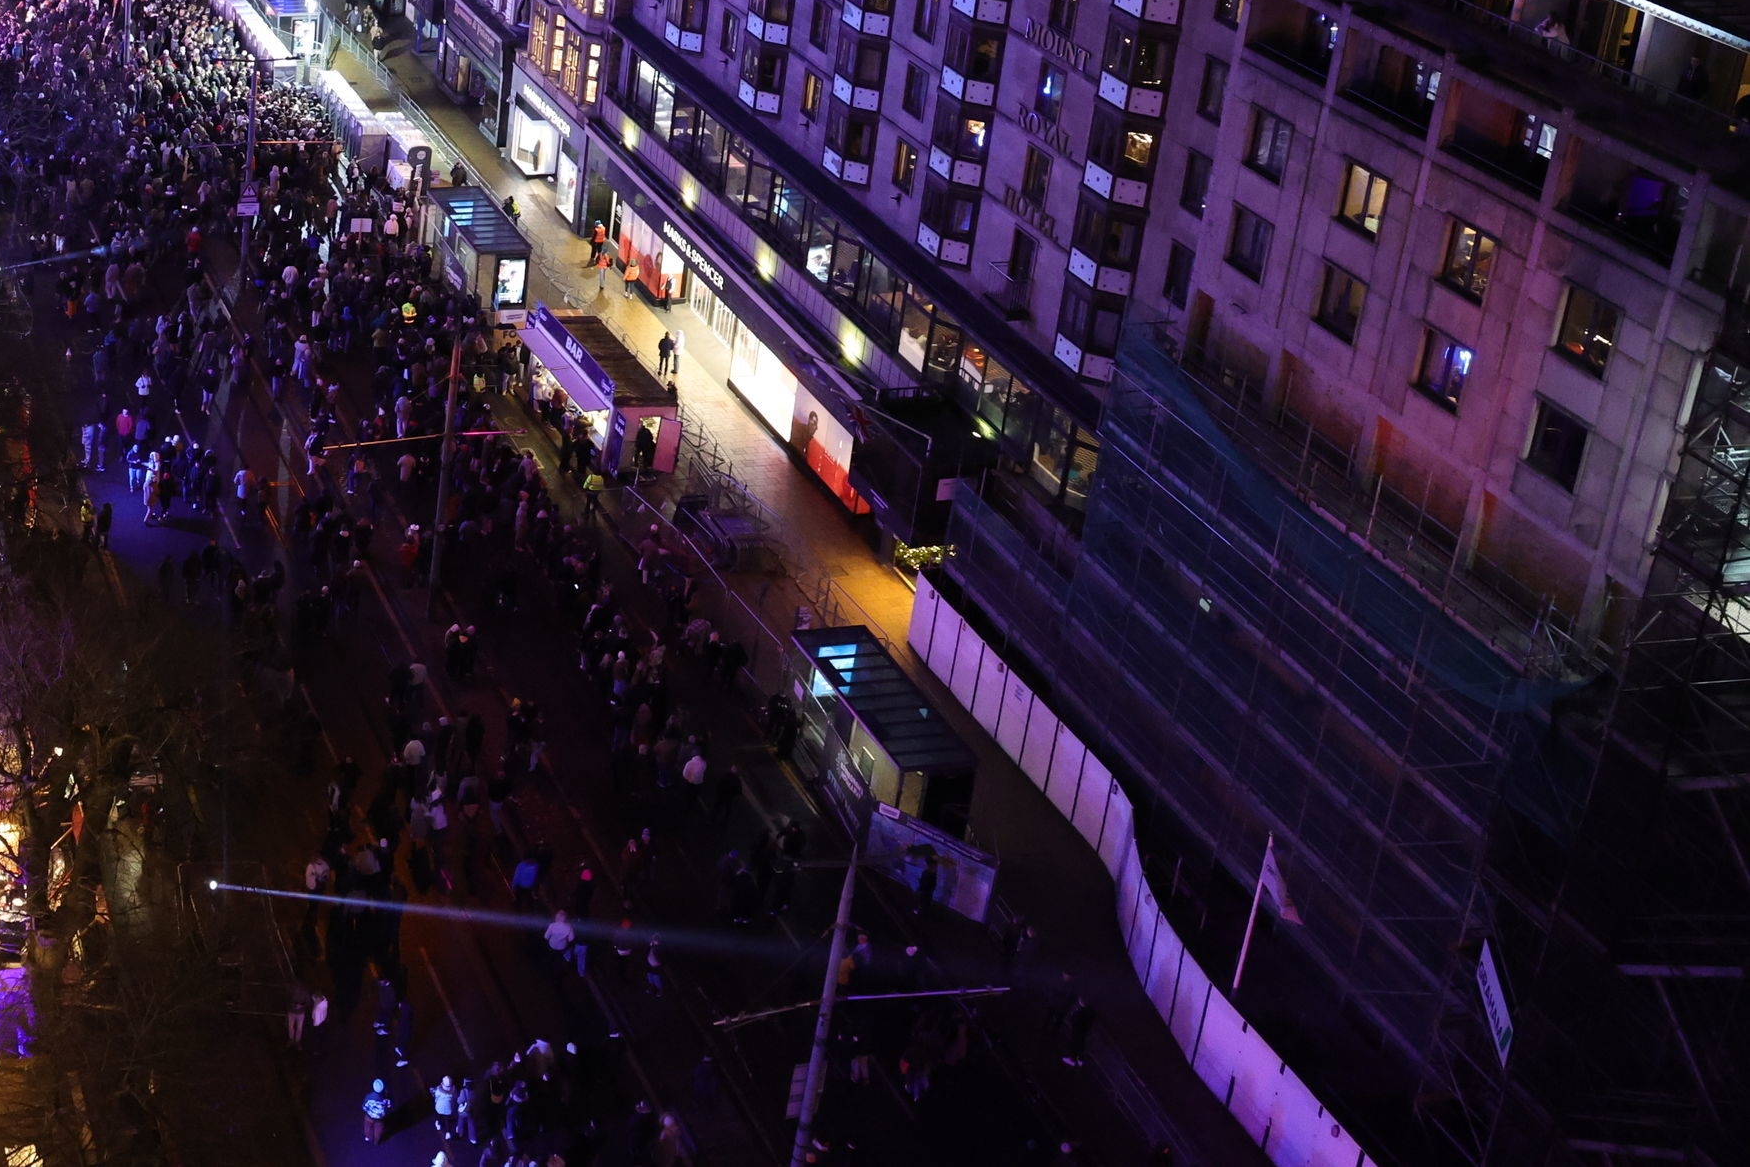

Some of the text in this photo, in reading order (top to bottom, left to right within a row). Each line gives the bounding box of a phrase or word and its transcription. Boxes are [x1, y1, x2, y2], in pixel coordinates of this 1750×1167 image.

[1025, 18, 1091, 73] MOUNT
[1018, 102, 1073, 160] ROYAL
[1004, 184, 1059, 244] HOTEL
[663, 220, 688, 253] MARKS
[690, 249, 725, 291] SPENCER
[565, 336, 583, 364] BAR
[1478, 961, 1503, 1041] GRAHAM
